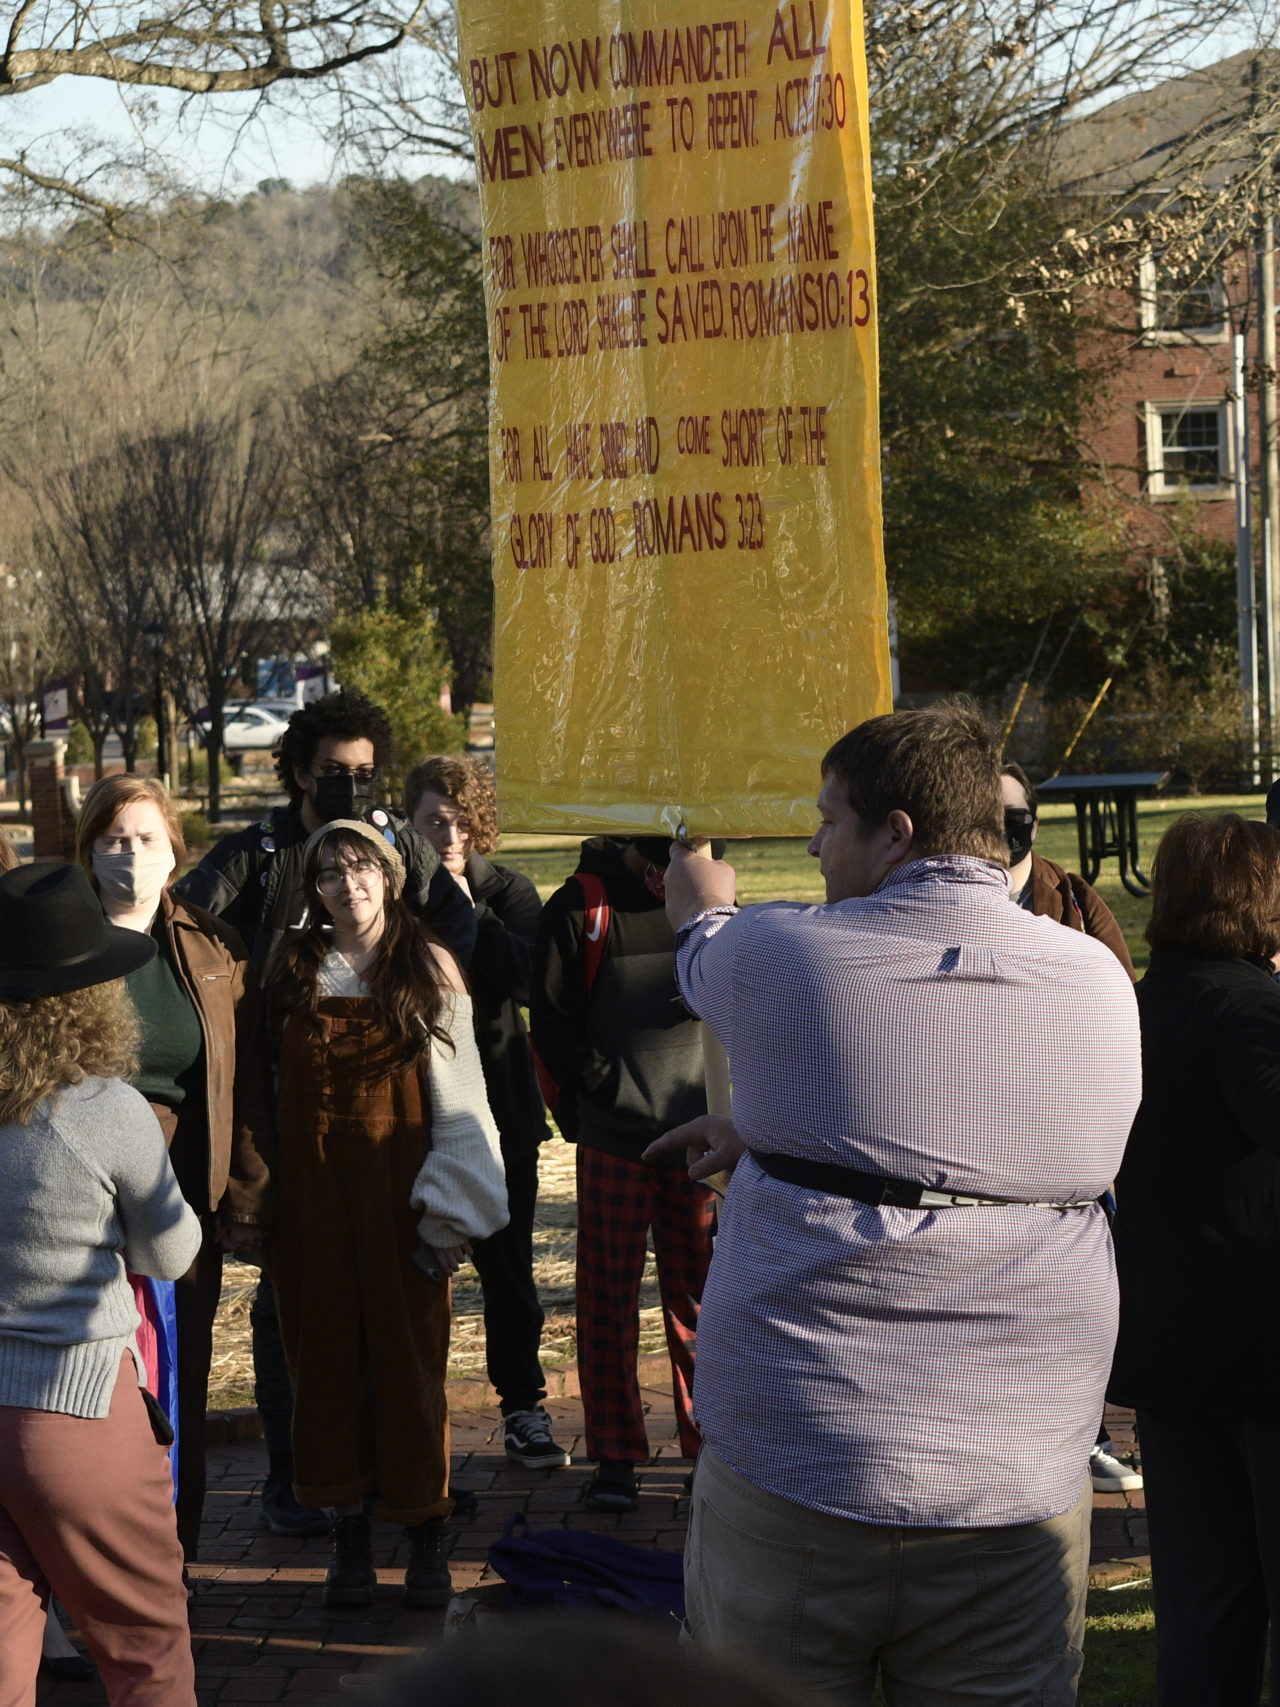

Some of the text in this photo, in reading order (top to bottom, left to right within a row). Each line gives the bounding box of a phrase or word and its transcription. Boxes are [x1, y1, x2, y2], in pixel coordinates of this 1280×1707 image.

[470, 0, 826, 112] BUT NOW COMMANDETH ALL
[478, 122, 546, 184] MEN
[553, 101, 653, 171] EVERYWHERE
[666, 96, 695, 153] TO
[707, 89, 759, 150] REPENT.
[489, 200, 839, 291] FOR WHOSOEVER SHALL CALL UPON THE NAME
[494, 306, 511, 362] OF
[518, 302, 551, 359] THE
[554, 298, 590, 357] LORD
[501, 427, 523, 482] FOR
[533, 425, 553, 481] ALL
[634, 416, 660, 475] AND
[677, 415, 711, 455] COME
[721, 407, 765, 467] SHORT
[777, 406, 793, 465] OF
[800, 406, 827, 466] THE
[510, 512, 553, 569] GLORY
[566, 512, 581, 569] OF
[632, 491, 727, 558] ROMANS
[735, 492, 764, 550] 3:23
